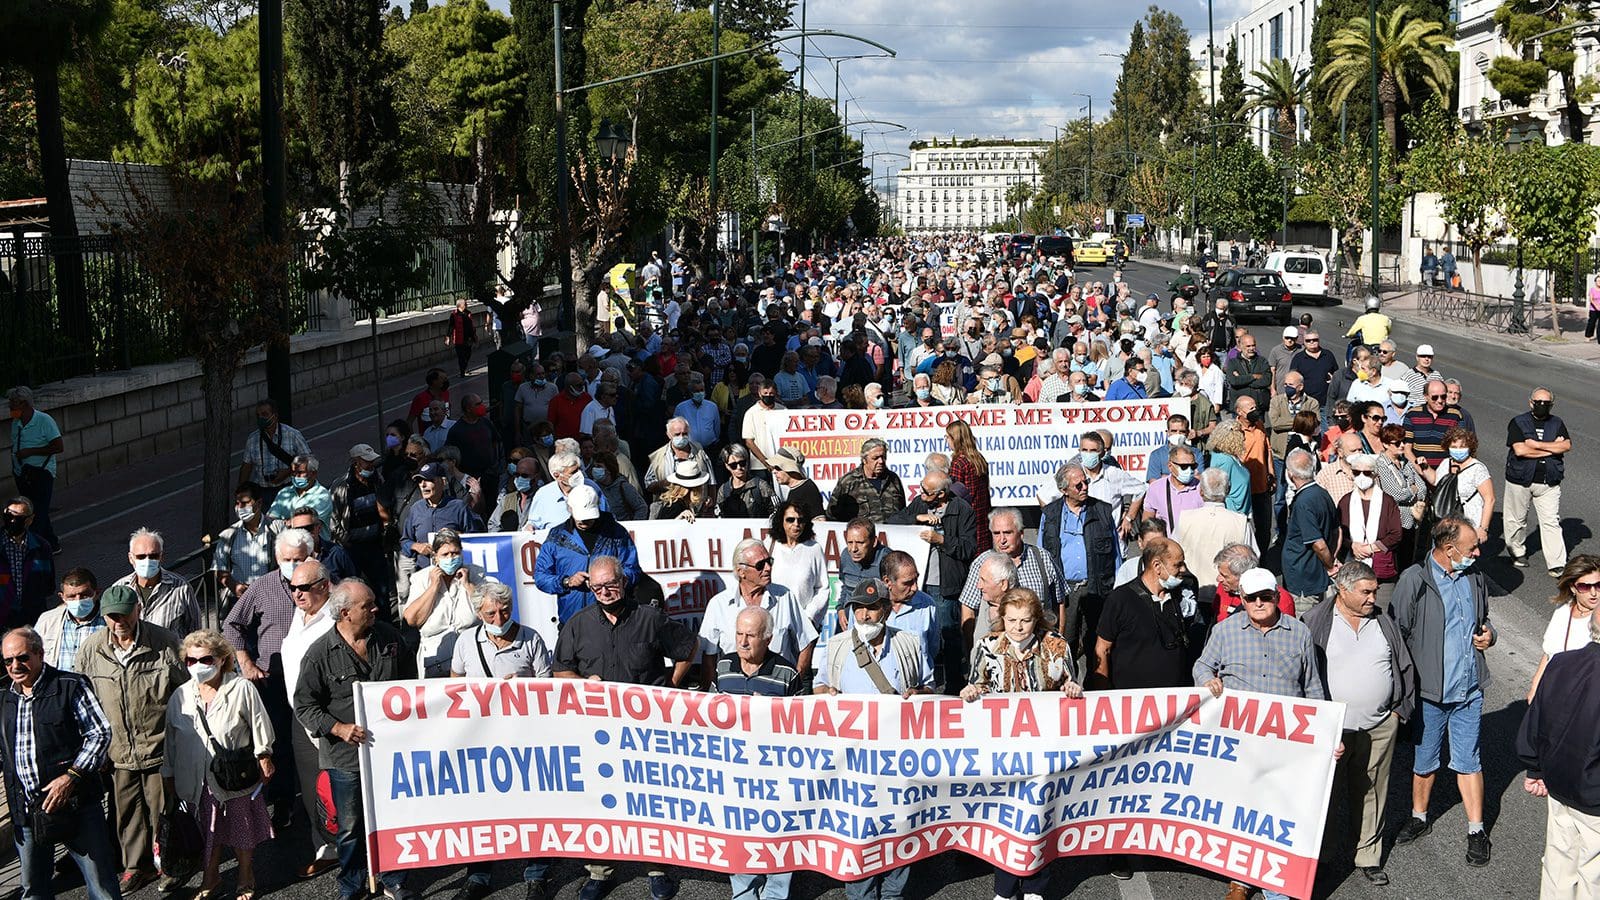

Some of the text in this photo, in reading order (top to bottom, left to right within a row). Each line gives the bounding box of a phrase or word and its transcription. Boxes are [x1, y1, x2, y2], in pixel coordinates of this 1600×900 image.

[786, 404, 1171, 432] ΔΕΝ ΘΑ ΖΗΣΟΥΜΕ ΜΕ ΨΙΧΟΥΛΑ
[887, 438, 911, 453] ΤΩΝ
[986, 436, 1005, 451] ΚΑΙ
[1008, 435, 1041, 450] ΟΛΩΝ
[1044, 434, 1068, 449] ΤΩΝ
[989, 460, 1014, 476] ΤΗΝ
[655, 538, 694, 569] ΠΙΑ
[708, 538, 723, 568] Η
[382, 681, 1317, 744] ΟΙ ΣΥΝΤΑΞΙΟΥΧΟΙ ΜΑΖΙ ΜΕ ΤΑ ΠΑΙΔΙΑ ΜΑΣ
[391, 745, 585, 800] ΑΠΑΙΤΟΥΜΕ
[620, 727, 1240, 777] ΑΥΞΗΣΕΙΣ ΣΤΟΥΣ ΜΙΣΘΟΥΣ ΚΑΙ ΤΙΣ ΣΥΝΤΑΞΕΙΣ
[623, 760, 1193, 808] ΜΕΙΩΣΗ ΤΗΣ ΤΙΜΗΣ ΤΩΝ ΒΑΣΙΚΩΝ ΑΓΑΘΩΝ
[626, 792, 1295, 847] ΜΕΤΡΑ ΠΡΟΣΤΑΣΙΑΣ ΤΗΣ ΥΓΕΙΑΣ ΚΑΙ ΤΗΣ ΖΩΗ ΜΑΣ
[395, 823, 1288, 887] ΣΥΝΕΡΓΑΖΟΜΕΝΕΣ ΣΥΝΤΑΞΙΟΥΧΙΚΕΣ ΟΡΓΑΝΩΣΕΙΣ
